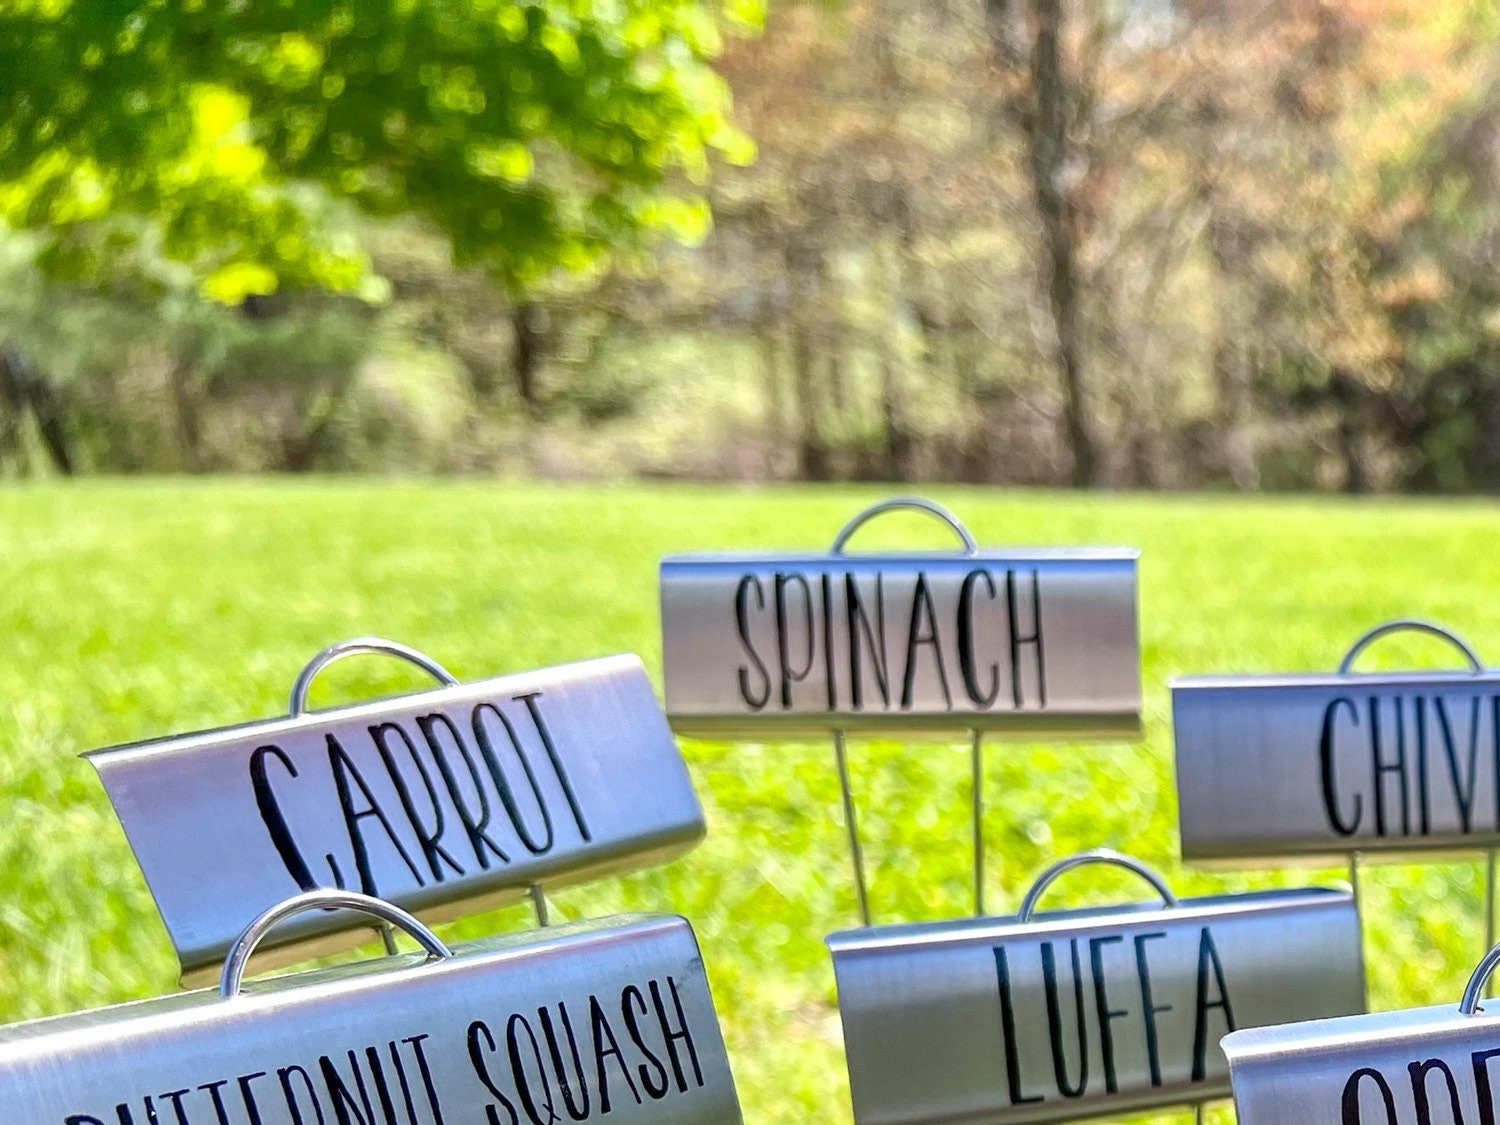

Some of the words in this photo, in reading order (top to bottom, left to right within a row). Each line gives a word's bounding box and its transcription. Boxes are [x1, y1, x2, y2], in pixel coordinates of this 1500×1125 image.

[734, 569, 1046, 711] SPINACH
[249, 692, 592, 910] CARROT
[992, 926, 1237, 1106] LUFFA
